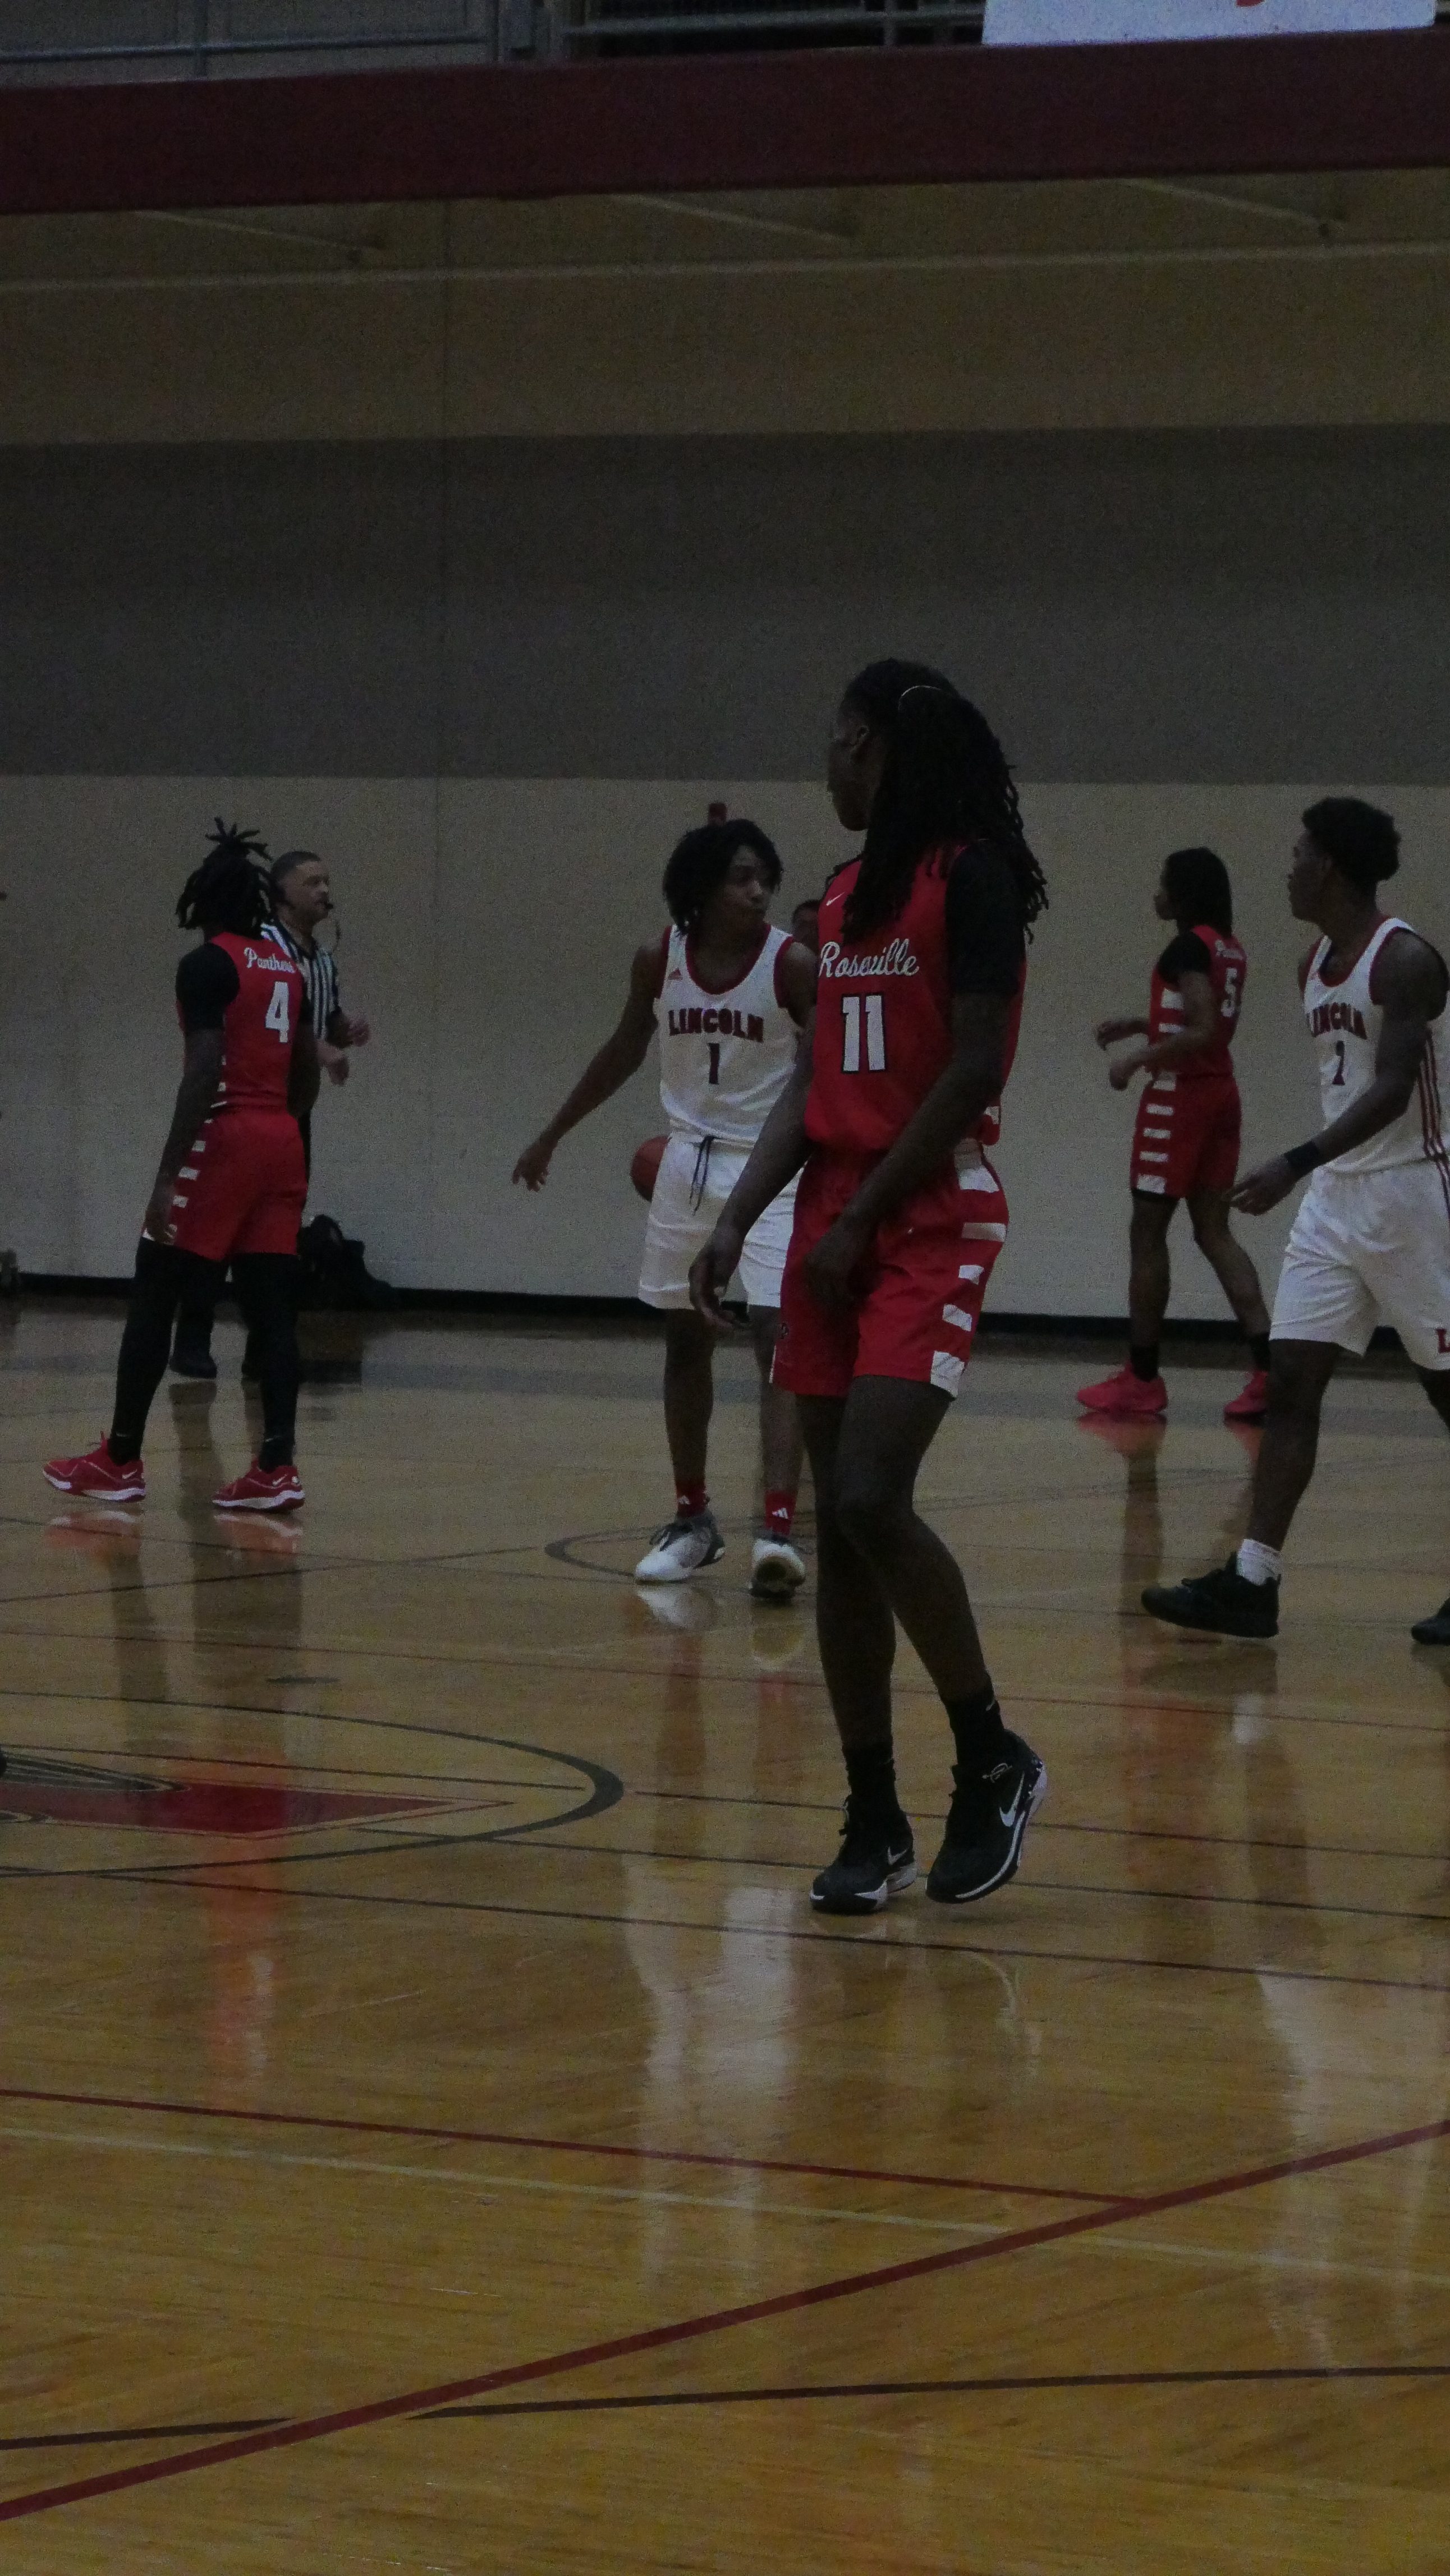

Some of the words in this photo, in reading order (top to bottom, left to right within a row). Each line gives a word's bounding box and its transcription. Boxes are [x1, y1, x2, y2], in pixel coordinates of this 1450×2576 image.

[818, 938, 920, 978] Roseville
[265, 981, 289, 1043] 4
[1220, 967, 1238, 1018] 5
[668, 1008, 764, 1042] LINCOLN
[841, 993, 887, 1073] 11
[708, 1042, 721, 1085] 1
